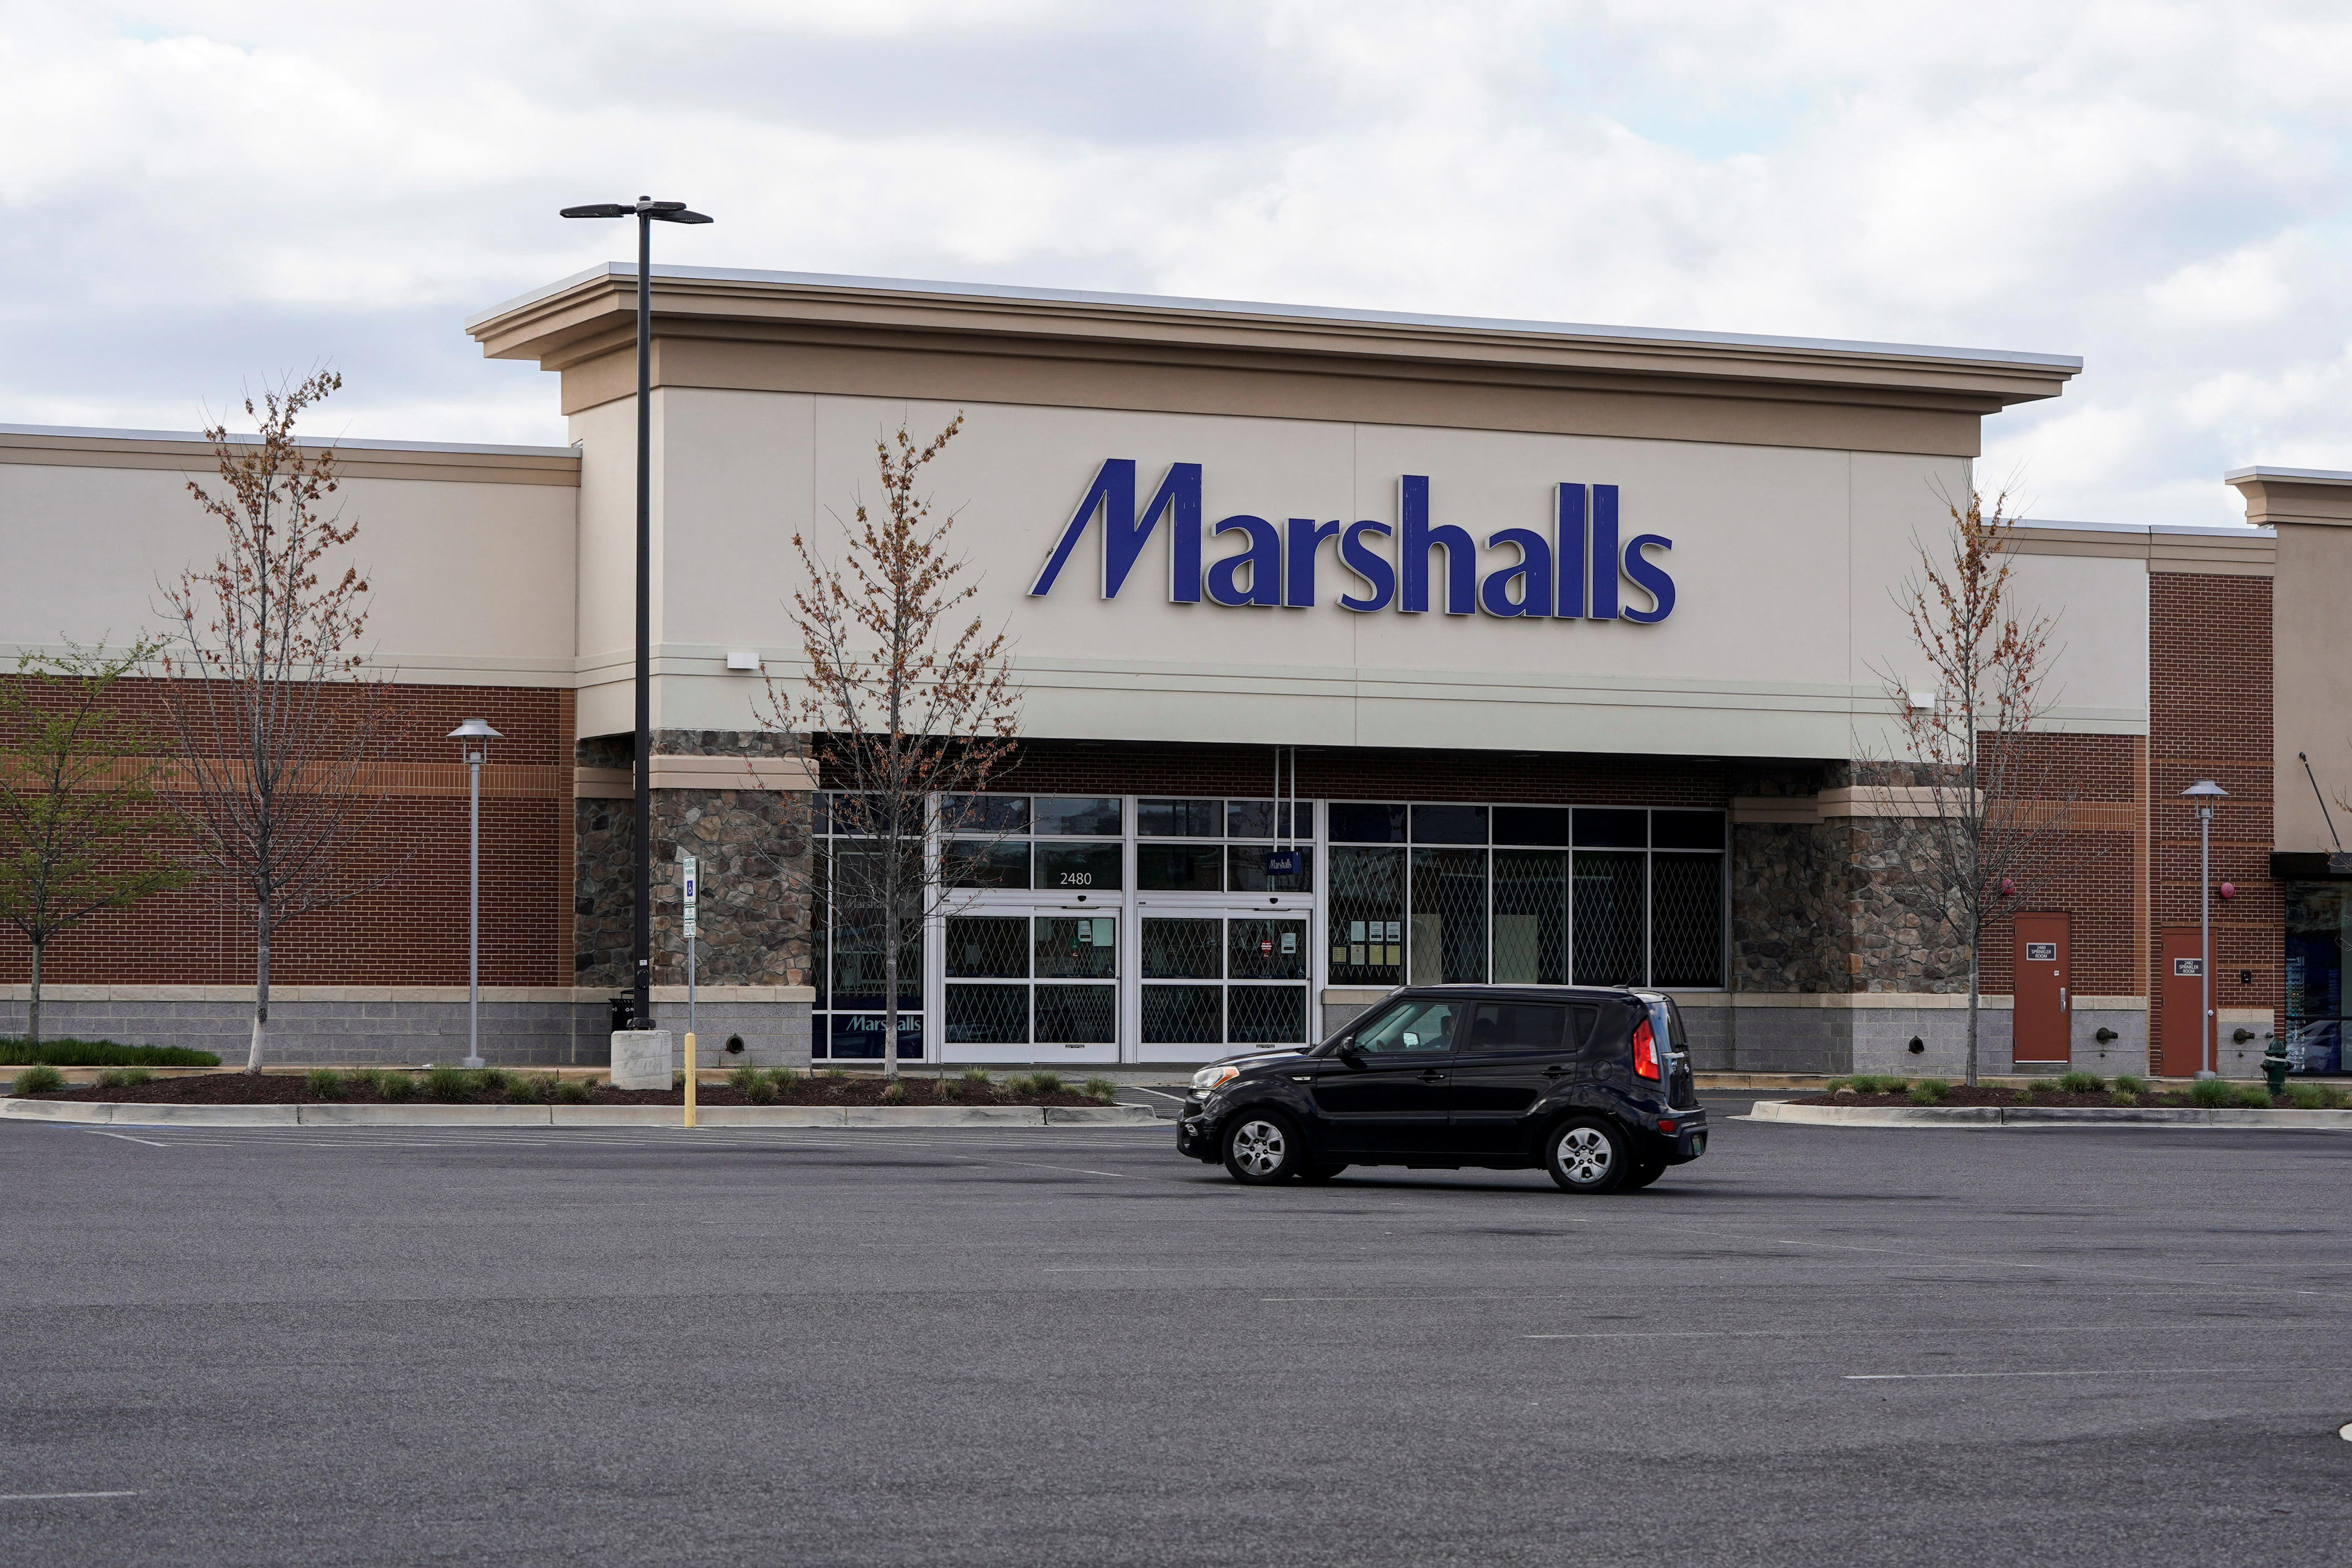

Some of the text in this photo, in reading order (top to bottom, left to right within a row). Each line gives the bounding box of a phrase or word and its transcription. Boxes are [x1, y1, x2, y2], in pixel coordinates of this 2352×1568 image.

[1027, 457, 1676, 625] Marshalls
[1269, 858, 1292, 870] Marshalls
[1060, 872, 1092, 885] 2480
[846, 1015, 922, 1031] Marsalls
